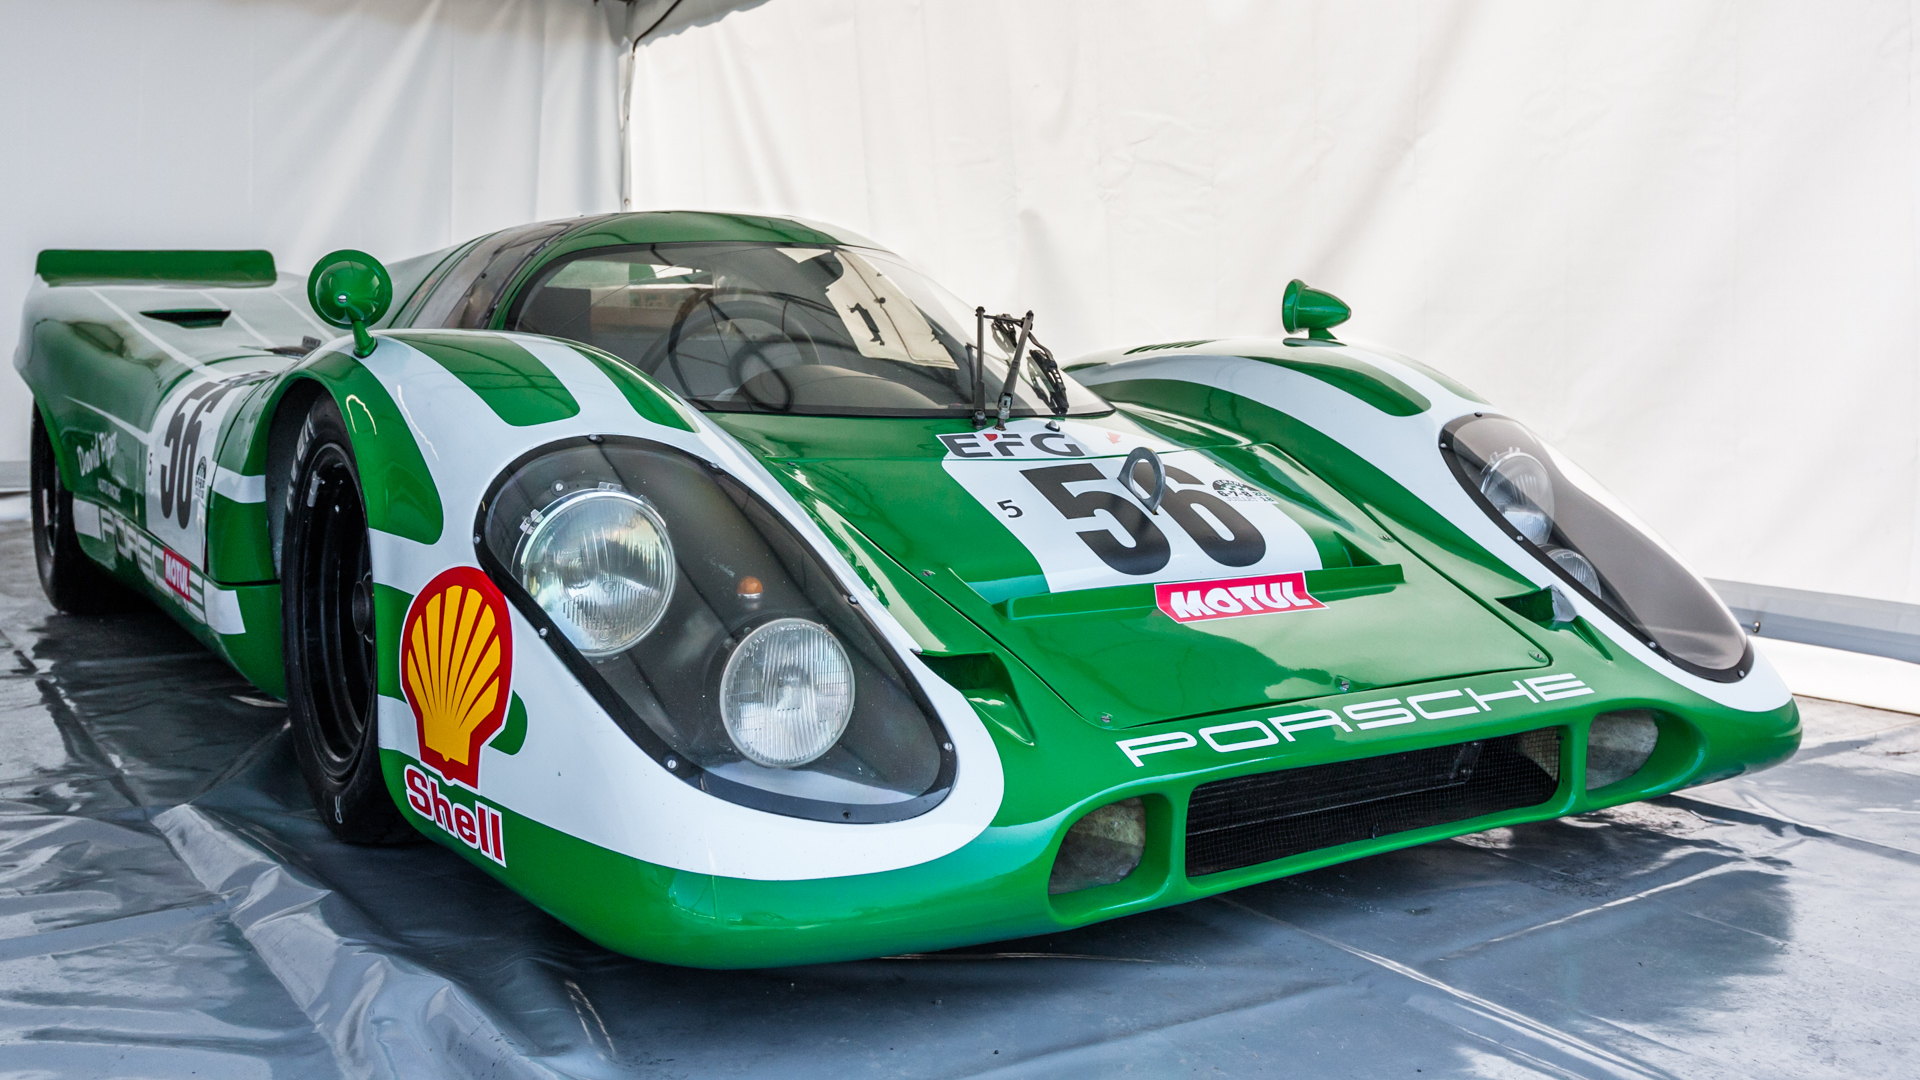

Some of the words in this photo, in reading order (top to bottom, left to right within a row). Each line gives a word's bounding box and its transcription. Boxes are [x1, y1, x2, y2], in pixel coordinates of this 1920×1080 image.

[160, 381, 232, 529] 56
[940, 433, 1085, 458] EFG
[997, 499, 1023, 519] 5
[1019, 462, 1267, 576] 56
[165, 552, 191, 598] MOTUL
[1169, 580, 1313, 619] MOTUL
[1115, 672, 1596, 768] PORSCHE
[404, 764, 507, 868] Shell
